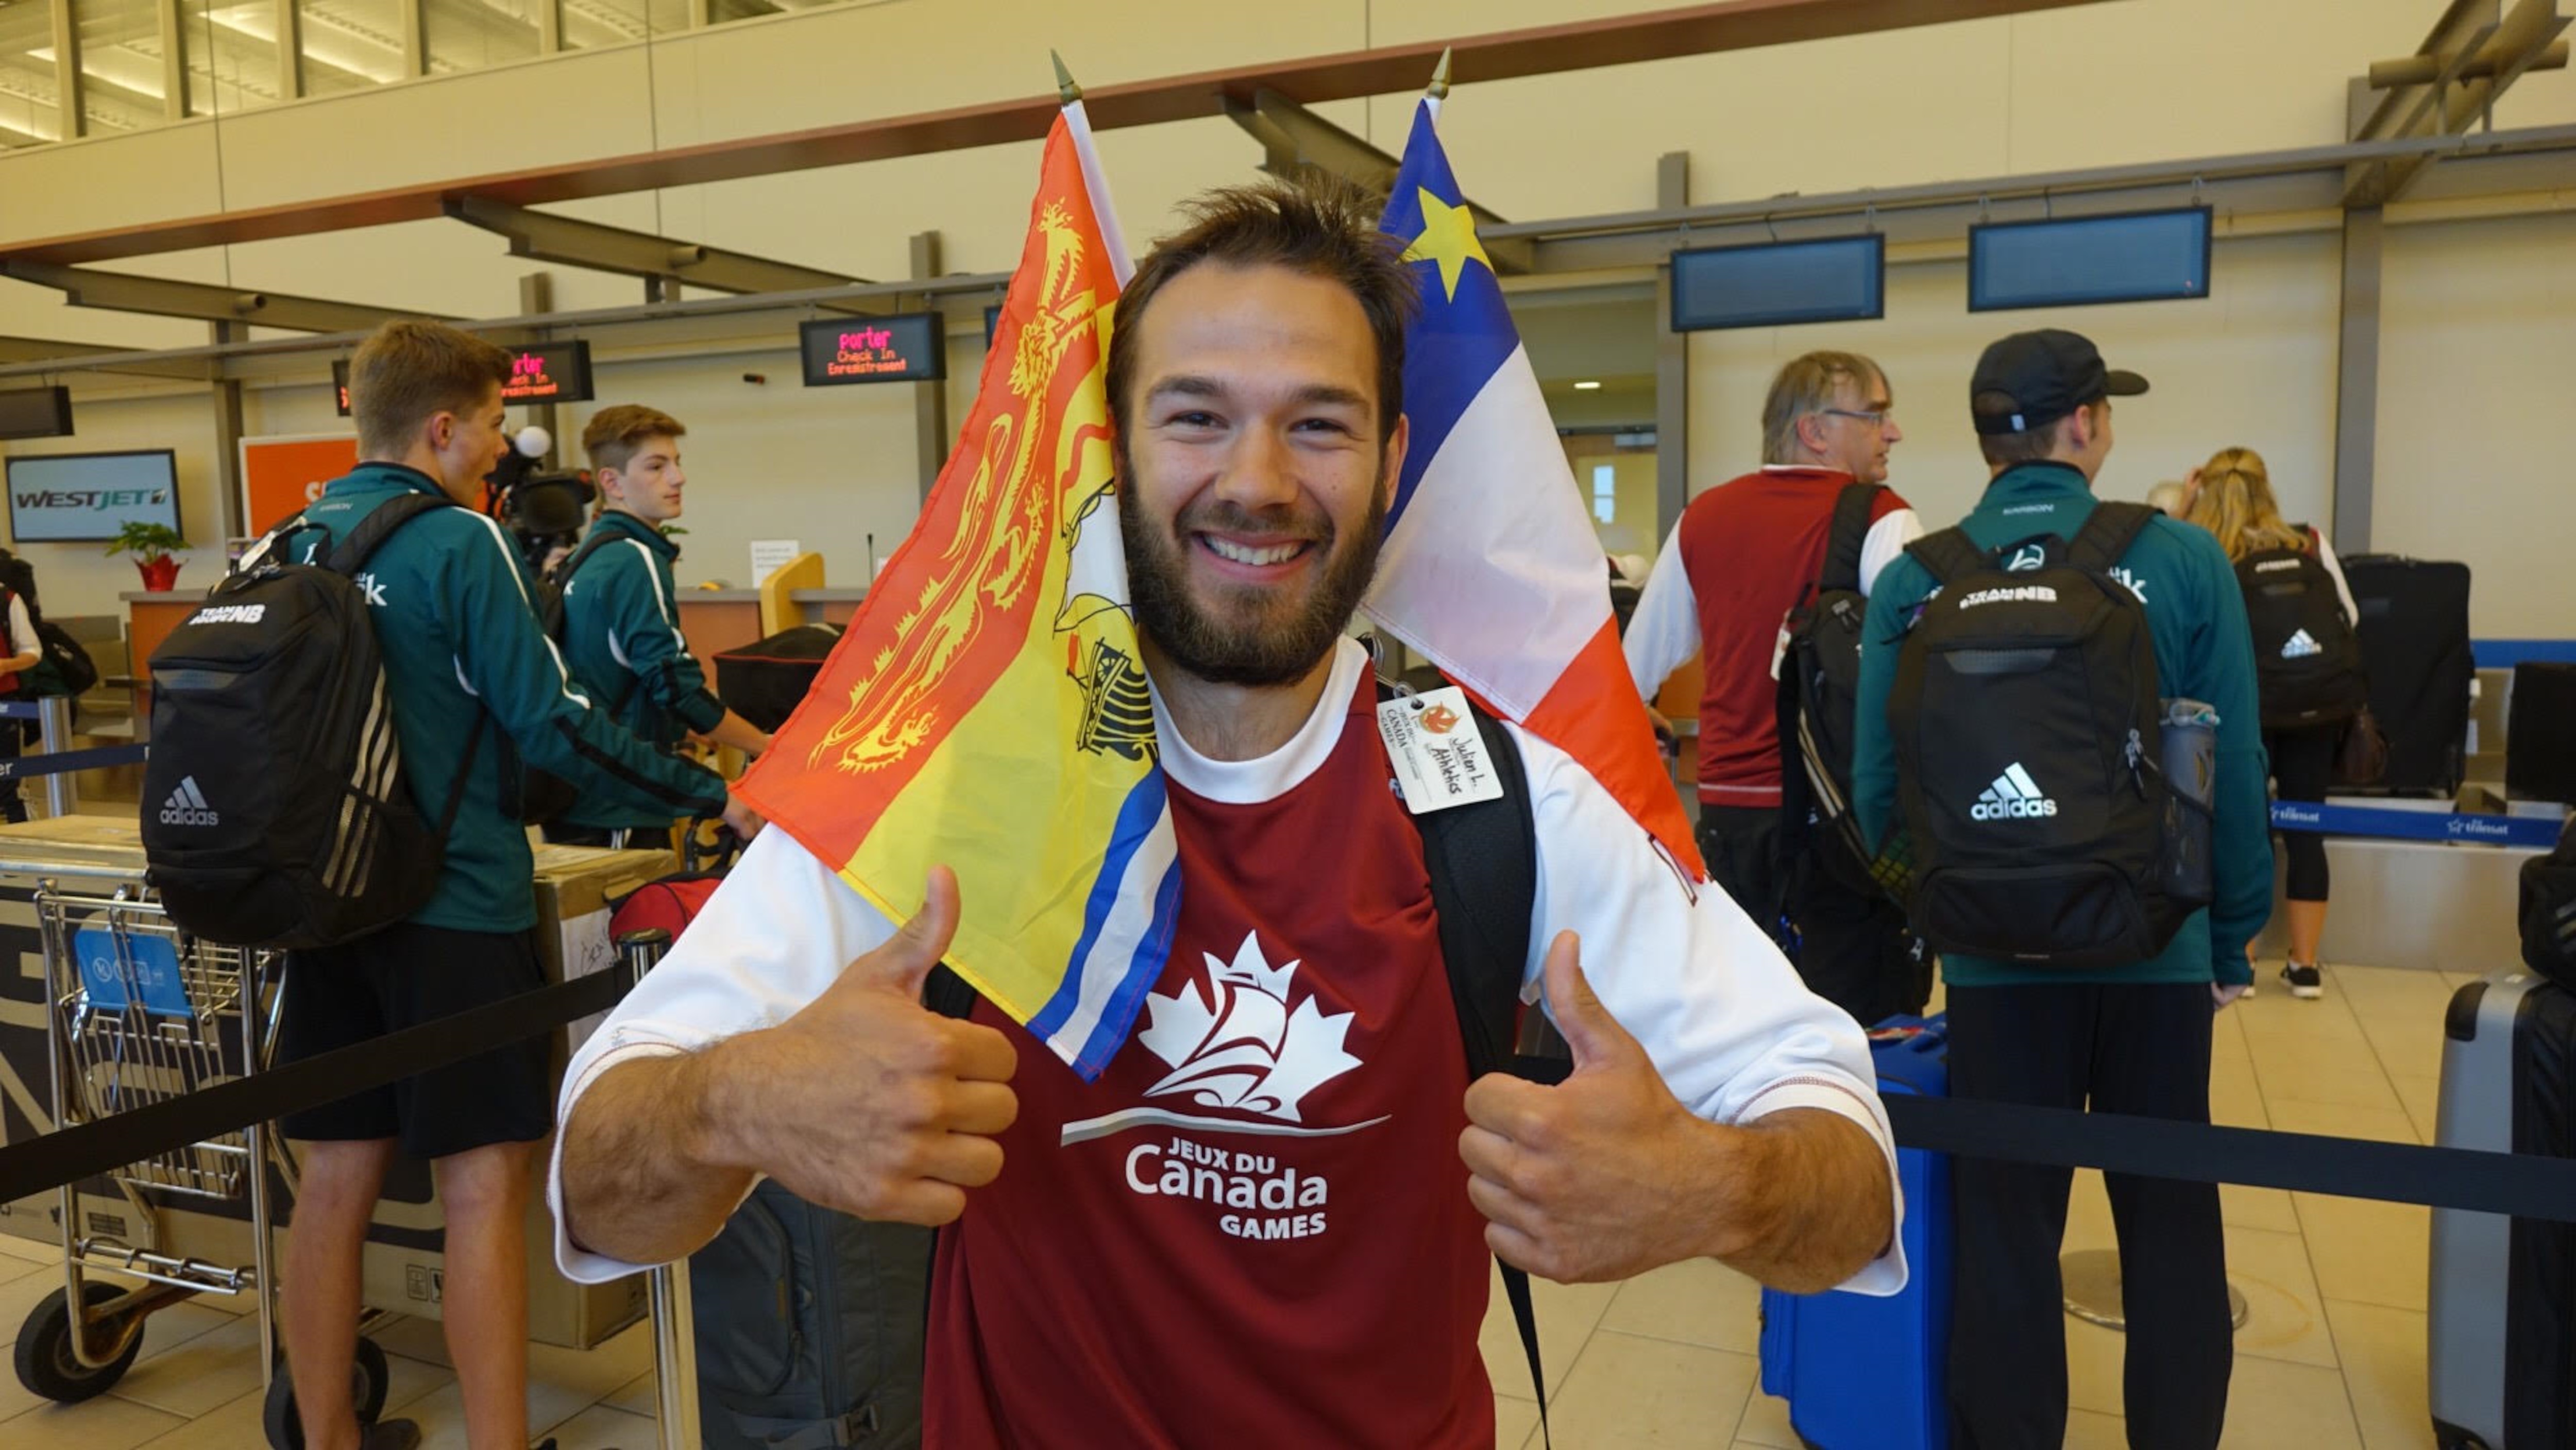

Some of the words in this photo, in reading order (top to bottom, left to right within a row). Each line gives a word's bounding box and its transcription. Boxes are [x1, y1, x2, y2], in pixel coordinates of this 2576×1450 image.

[880, 347, 896, 360] In
[16, 488, 150, 511] WESTJET
[1386, 709, 1408, 748] CANADA
[1452, 738, 1477, 772] Julien
[1431, 748, 1463, 794] Athletics
[160, 807, 218, 825] adidas
[1971, 798, 2058, 821] adidas
[1168, 1136, 1229, 1171] JEUX
[1235, 1153, 1275, 1174] DU
[1125, 1143, 1328, 1210] Canada
[1219, 1212, 1327, 1240] GAMES
